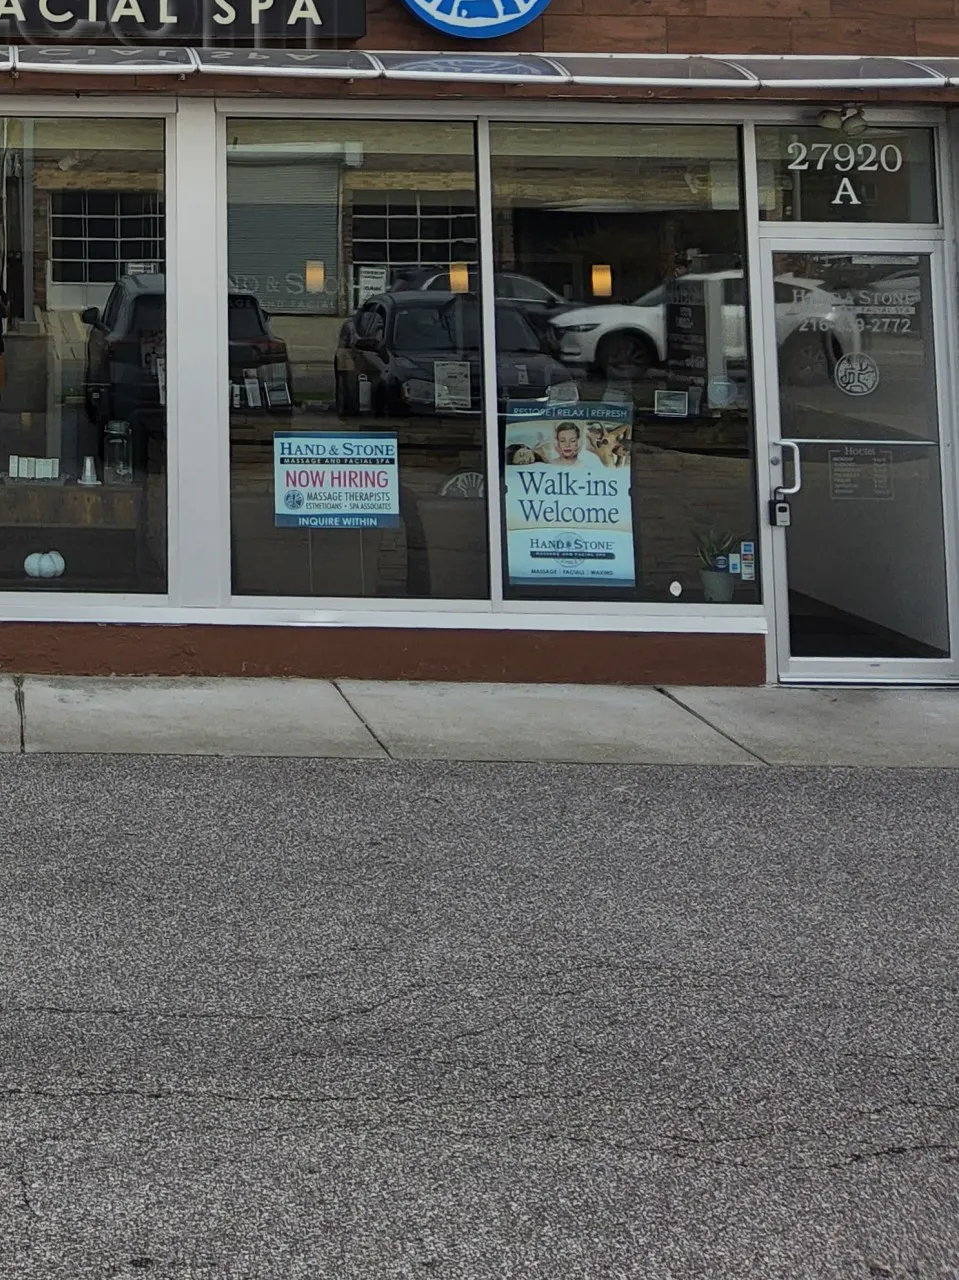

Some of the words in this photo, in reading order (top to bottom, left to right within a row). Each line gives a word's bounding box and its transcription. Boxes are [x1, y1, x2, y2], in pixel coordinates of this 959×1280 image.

[787, 142, 903, 172] 27920
[831, 178, 862, 205] A
[557, 408, 585, 417] RELAX
[591, 409, 627, 418] REFRESH
[280, 442, 326, 456] HAND
[328, 443, 340, 456] &
[342, 442, 396, 456] STONE
[285, 470, 325, 488] NOW
[330, 470, 389, 488] HIRING
[517, 471, 618, 497] Walk-ins
[306, 492, 343, 502] MASSAGE
[344, 492, 391, 502] THERAPISTS
[306, 502, 342, 510] ESTHETICIANS
[349, 502, 360, 510] SPA
[360, 502, 392, 510] ASSOCIATES
[518, 499, 620, 524] Welcome
[298, 517, 340, 526] INQUIRE
[342, 517, 378, 526] WITHIN
[529, 539, 564, 549] HAND
[574, 539, 613, 550] STONE
